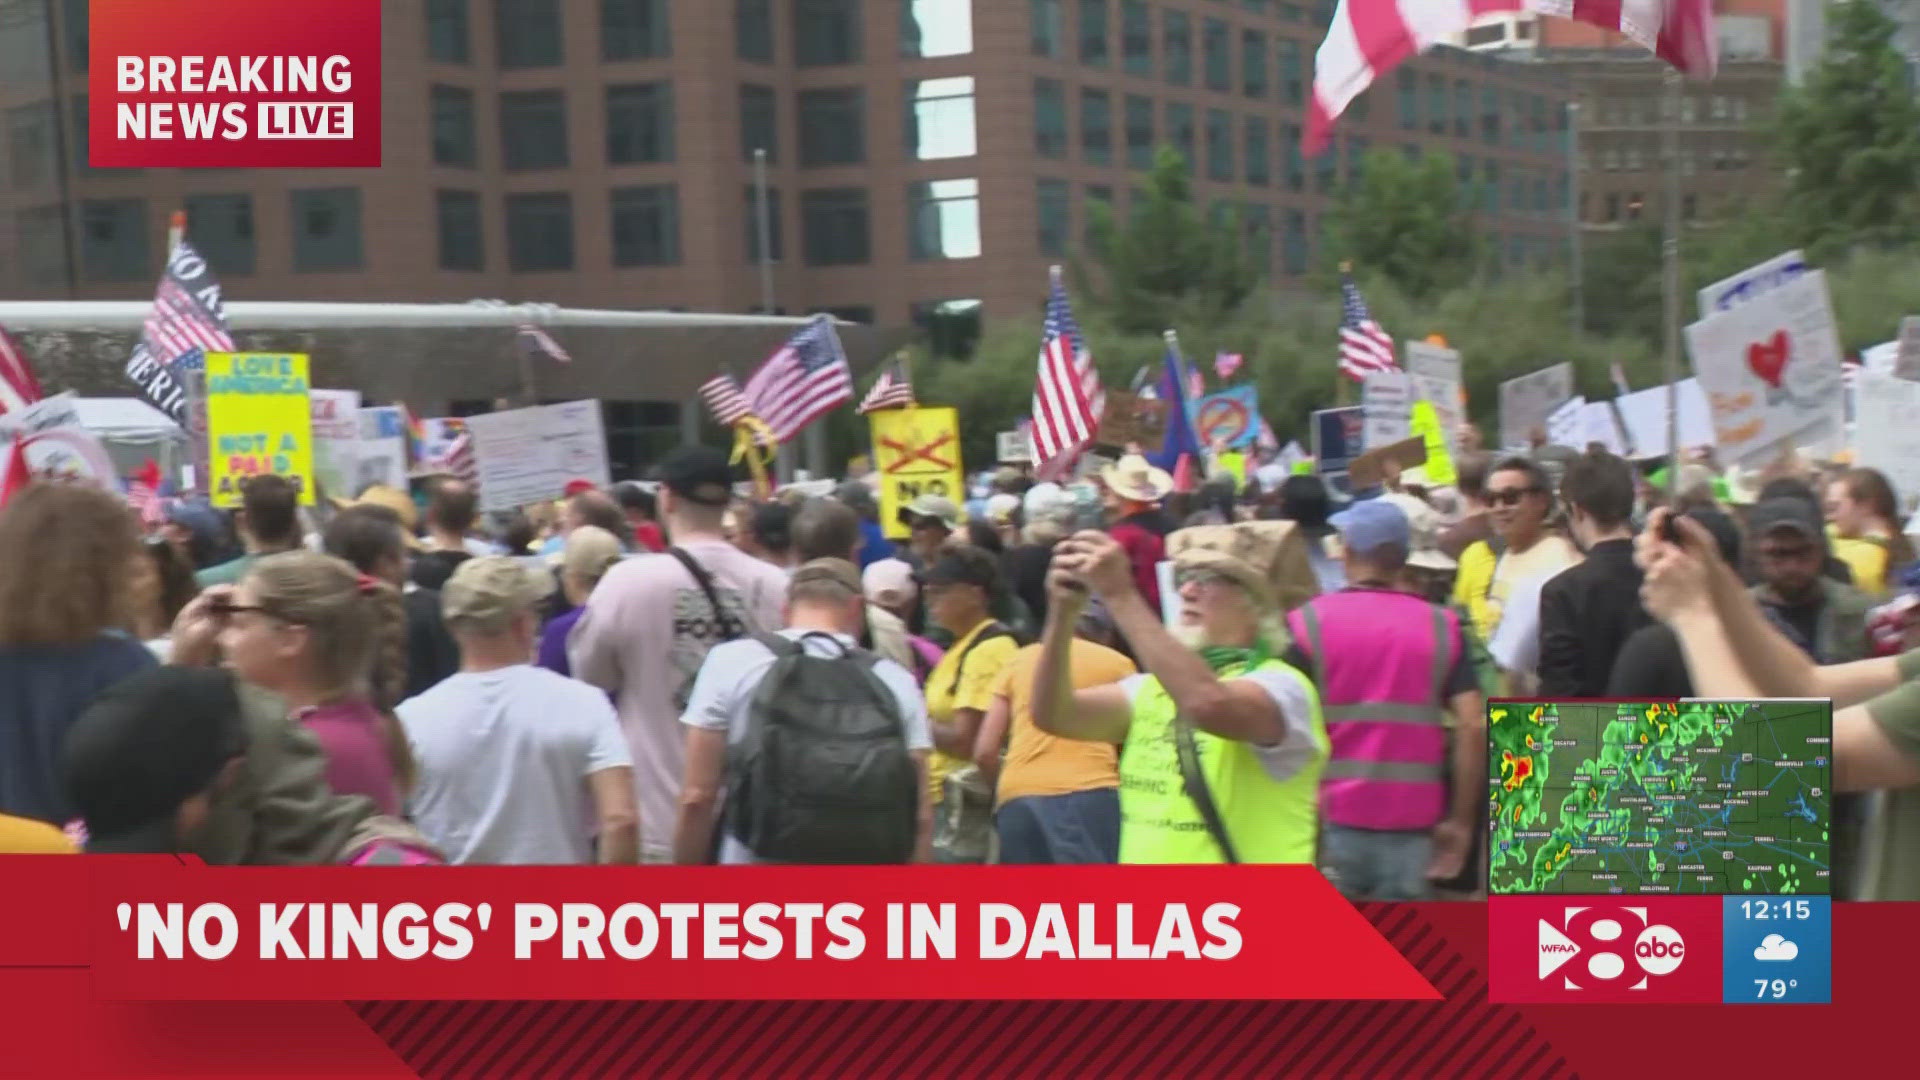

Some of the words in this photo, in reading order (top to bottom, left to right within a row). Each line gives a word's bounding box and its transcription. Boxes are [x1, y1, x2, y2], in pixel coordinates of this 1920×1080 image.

[232, 356, 292, 376] LOVE
[218, 433, 268, 453] NOT
[280, 433, 297, 451] A
[228, 454, 291, 475] PAID
[896, 479, 950, 500] NO
